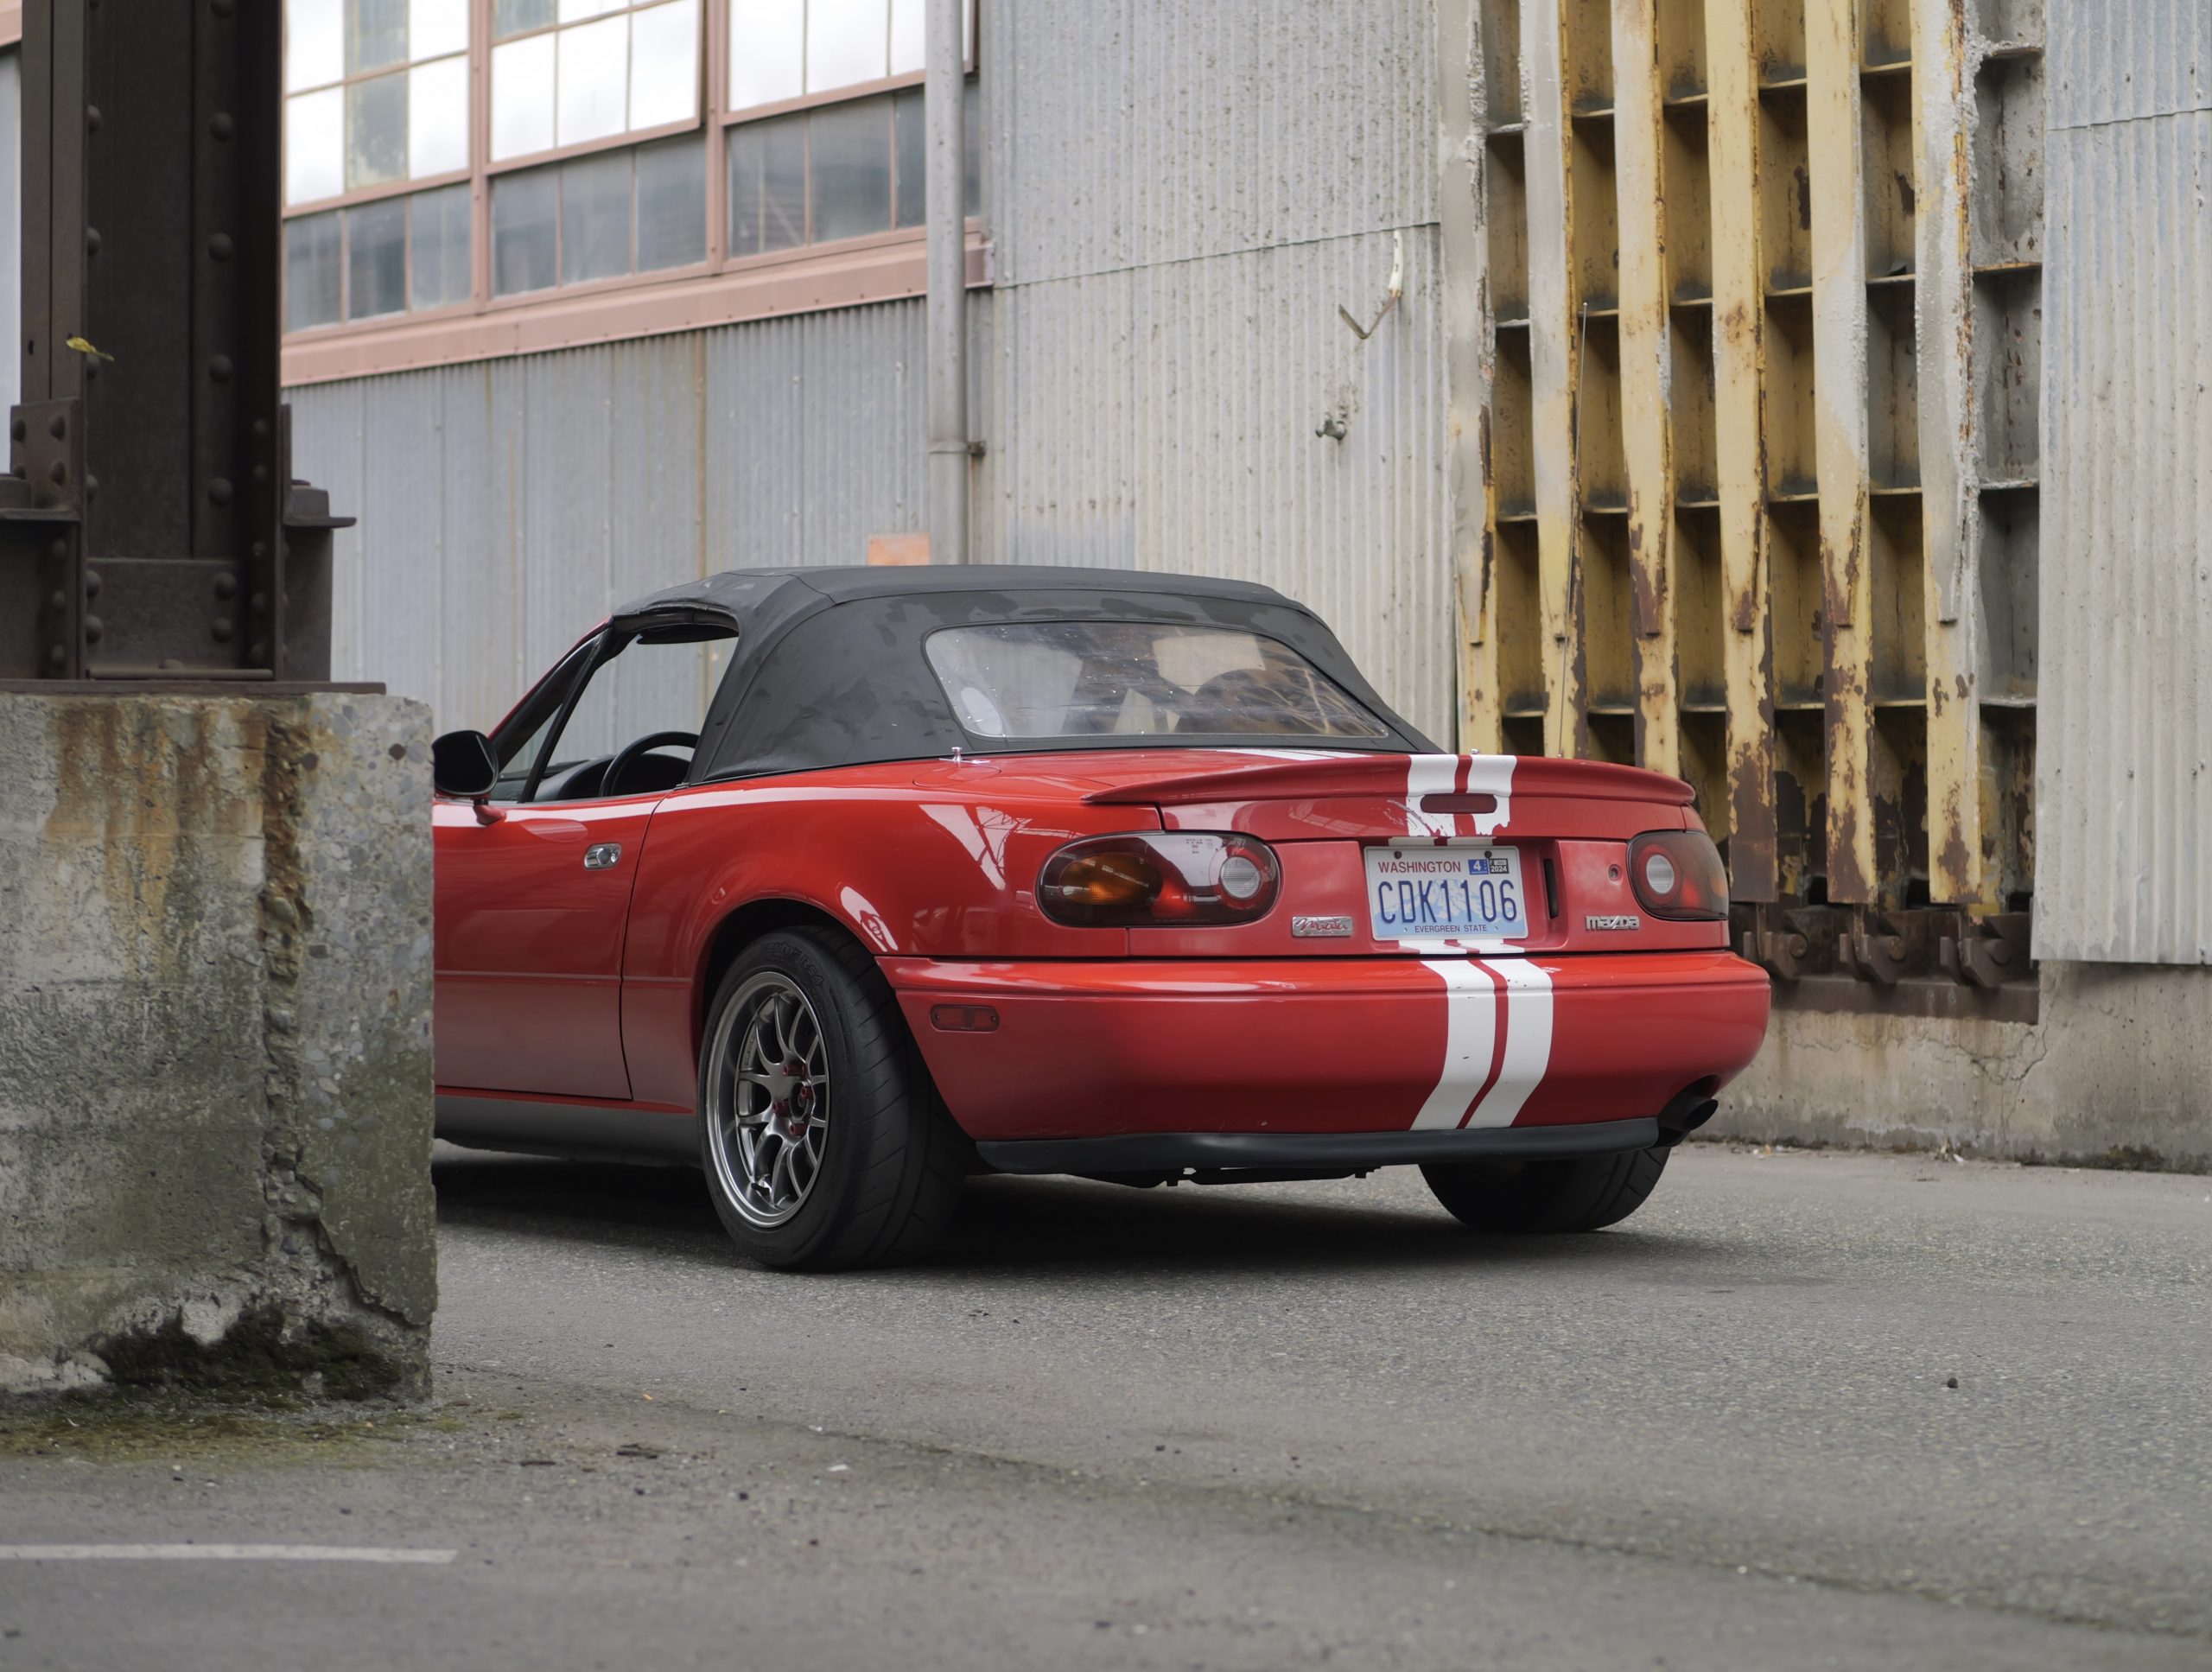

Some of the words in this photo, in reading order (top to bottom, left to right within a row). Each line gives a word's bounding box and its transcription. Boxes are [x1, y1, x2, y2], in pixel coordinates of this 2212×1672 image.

[1378, 861, 1461, 874] WASHINGTON
[1473, 860, 1482, 871] 4
[1378, 879, 1517, 924] CDK1106
